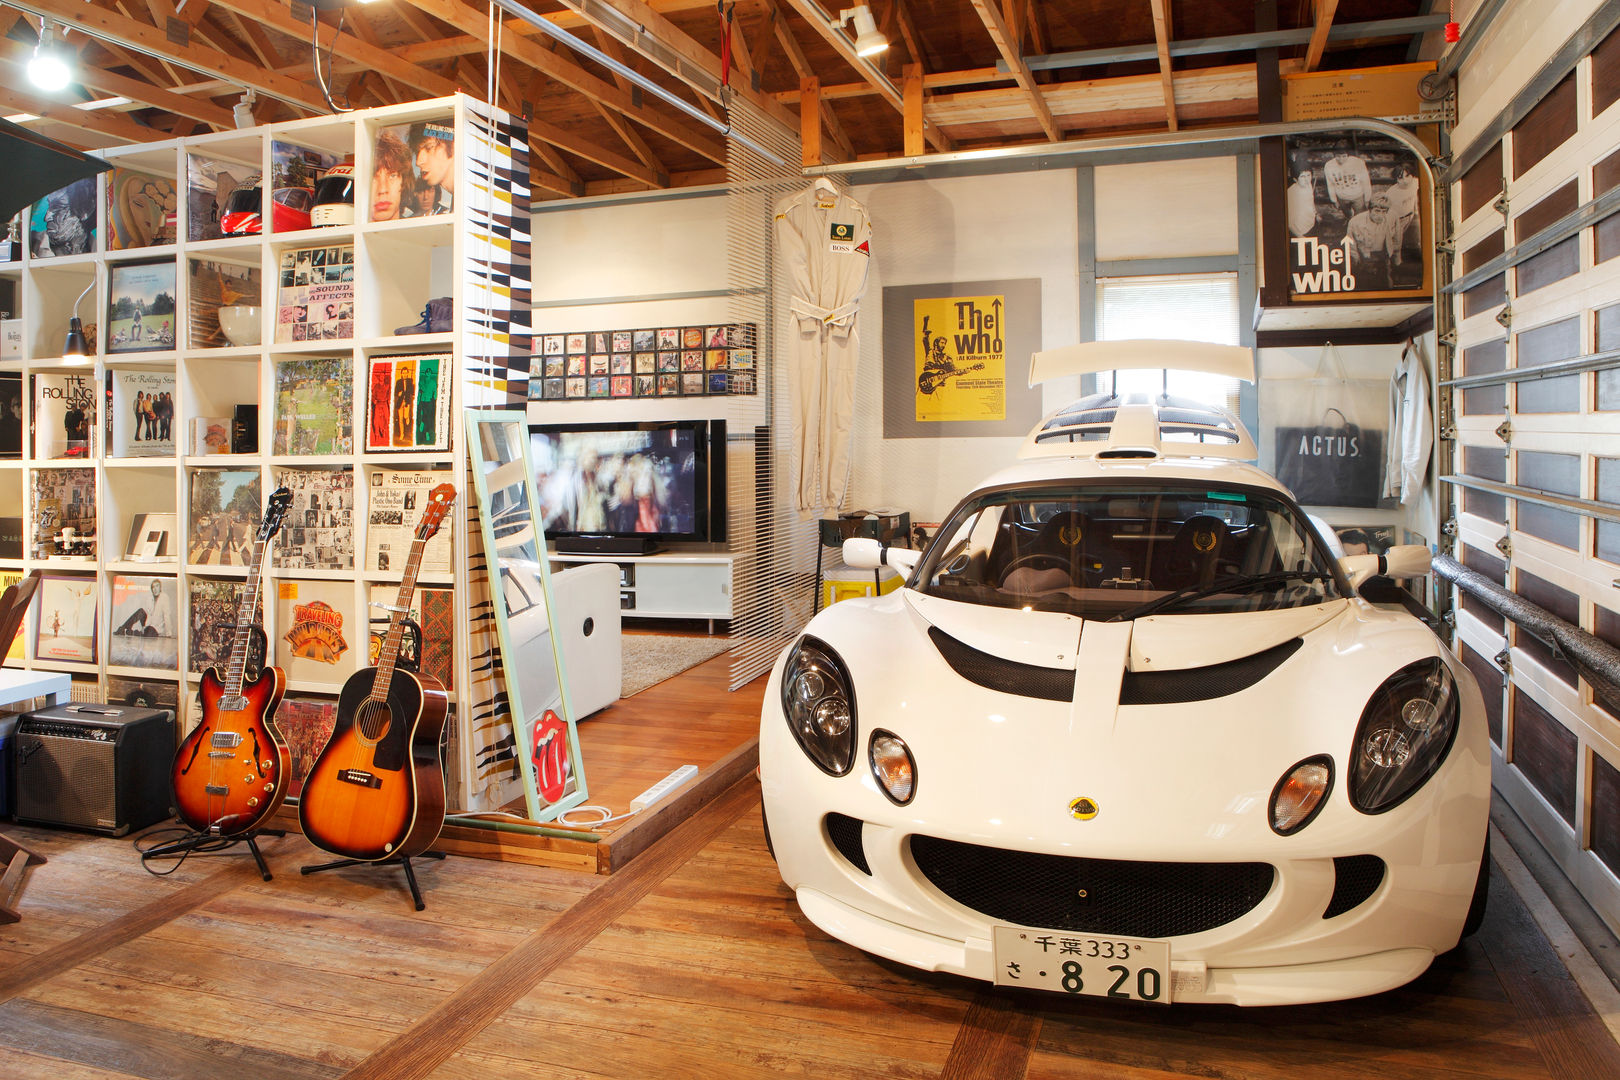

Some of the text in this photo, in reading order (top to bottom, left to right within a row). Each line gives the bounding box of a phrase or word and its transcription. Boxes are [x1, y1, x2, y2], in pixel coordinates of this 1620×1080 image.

[1291, 237, 1344, 266] The
[309, 292, 354, 301] AFFECTS
[316, 285, 350, 293] SOUND
[954, 301, 994, 330] The
[64, 375, 86, 388] THE
[124, 374, 137, 383] The
[138, 374, 162, 387] Rolling
[43, 387, 93, 400] ROLLING
[1299, 435, 1360, 457] ACTUS
[296, 606, 342, 628] TRAVELING
[1006, 961, 1022, 979] さ
[1107, 965, 1161, 1001] 20
